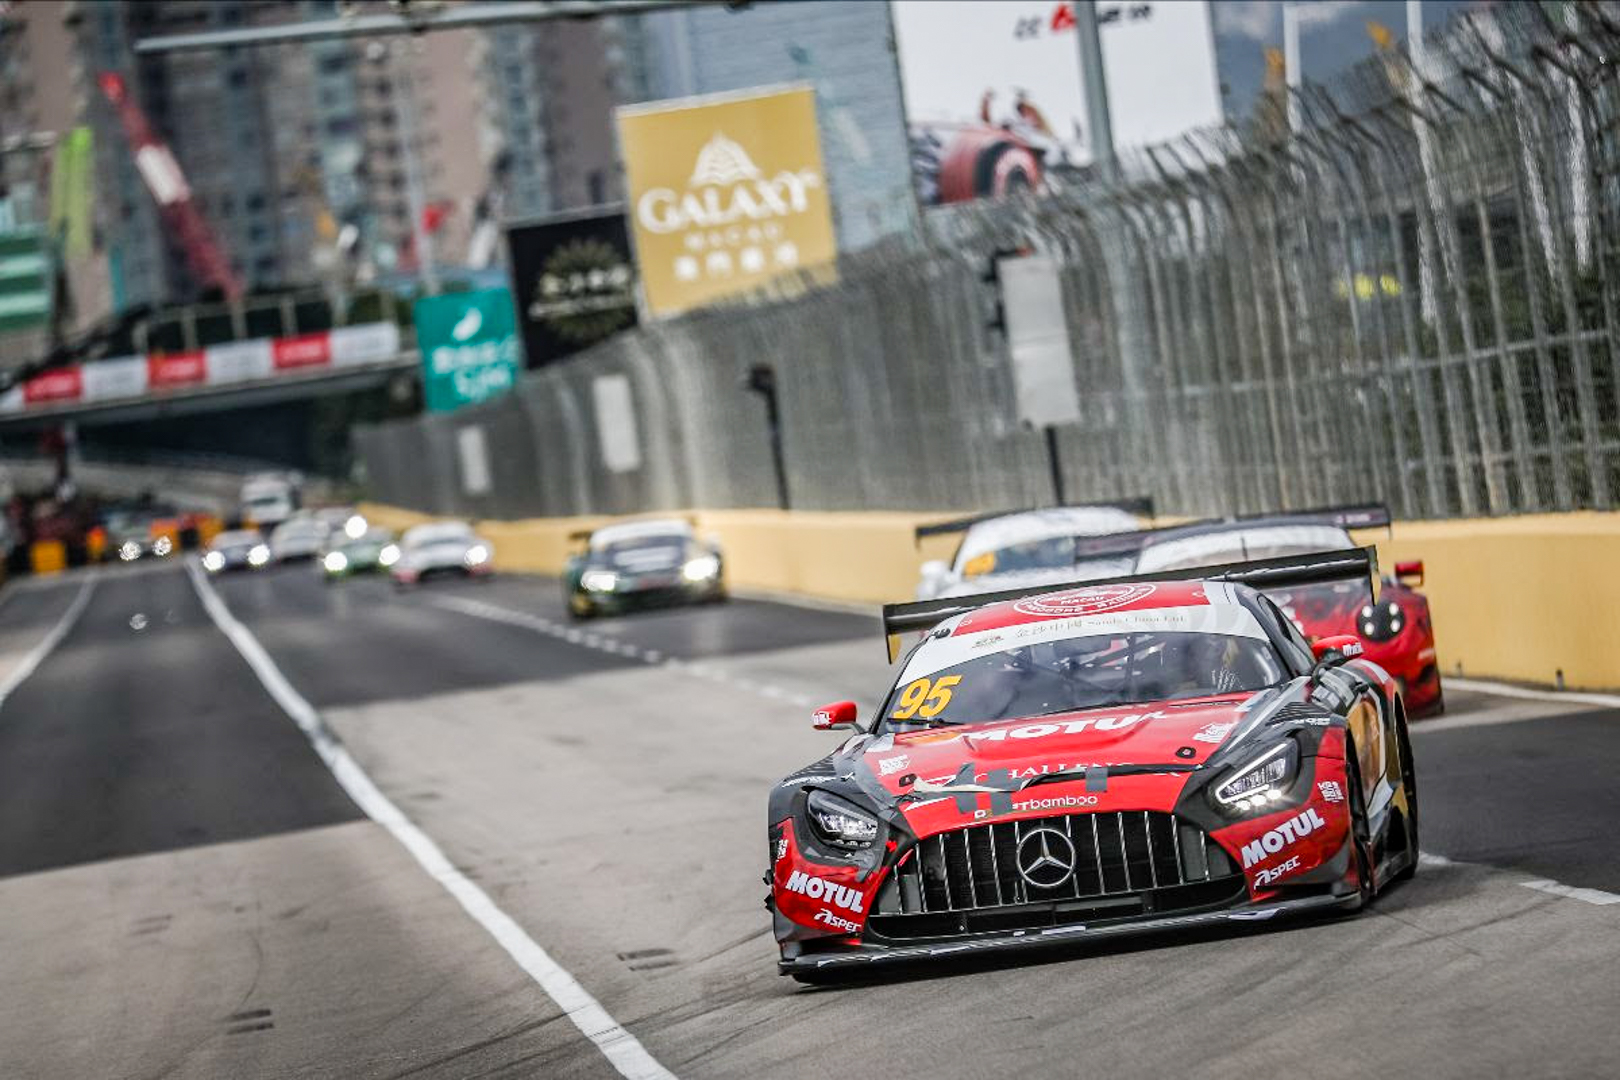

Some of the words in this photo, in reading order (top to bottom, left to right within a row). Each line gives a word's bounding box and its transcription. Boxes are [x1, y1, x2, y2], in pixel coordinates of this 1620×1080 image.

[637, 171, 820, 234] GALAXY
[893, 674, 962, 719] 95
[1241, 808, 1325, 869] MOTUL
[785, 870, 863, 913] MOTUL
